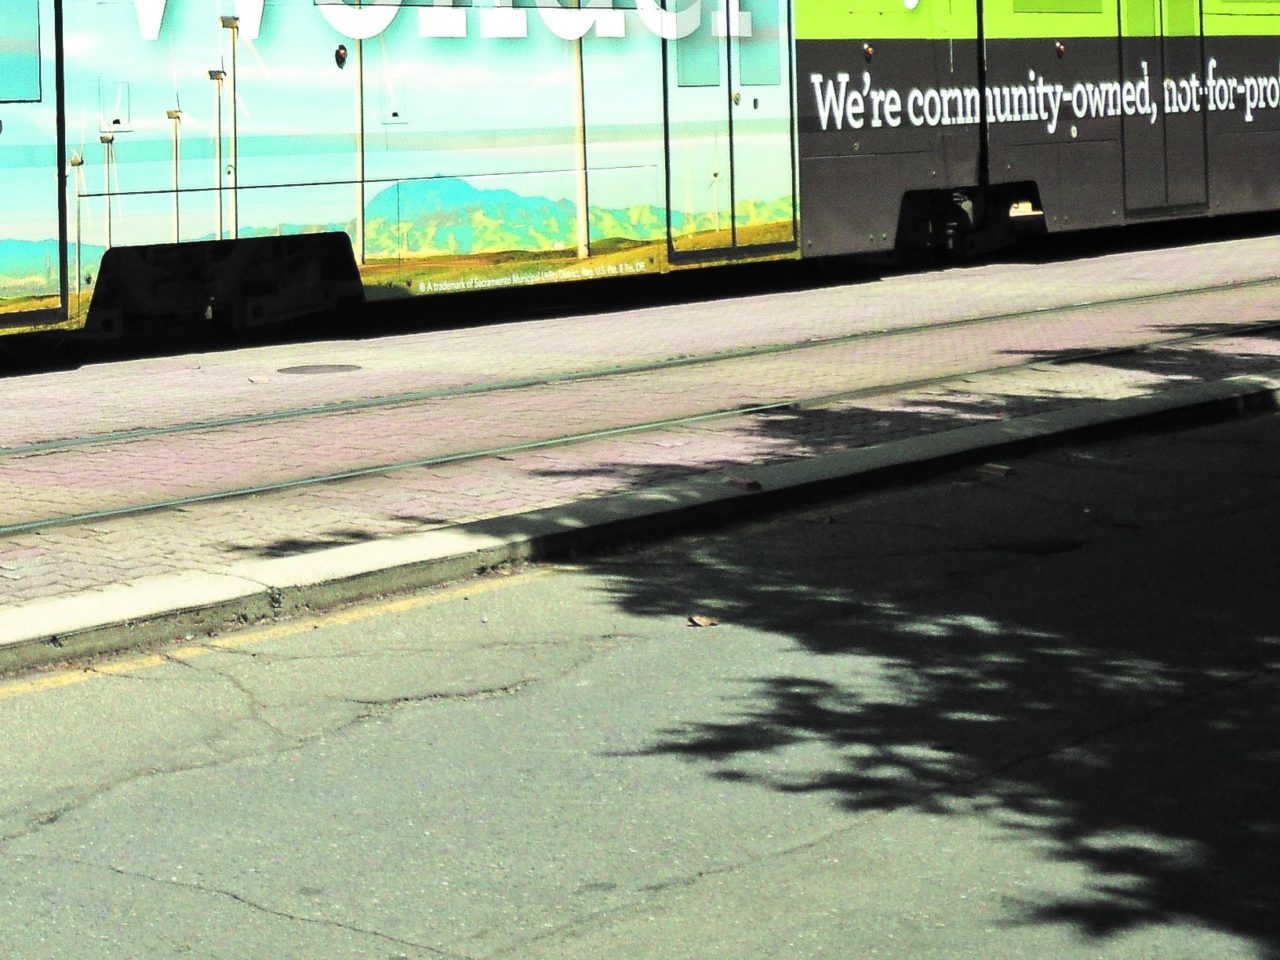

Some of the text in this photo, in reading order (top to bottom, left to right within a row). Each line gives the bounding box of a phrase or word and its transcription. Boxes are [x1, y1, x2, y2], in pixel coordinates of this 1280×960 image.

[810, 56, 1280, 135] We're community-owned, not-for-pro
[426, 281, 434, 292] A
[433, 278, 466, 291] trademark
[466, 278, 474, 289] of
[473, 275, 512, 289] Sacramento
[511, 272, 542, 285] Municipal
